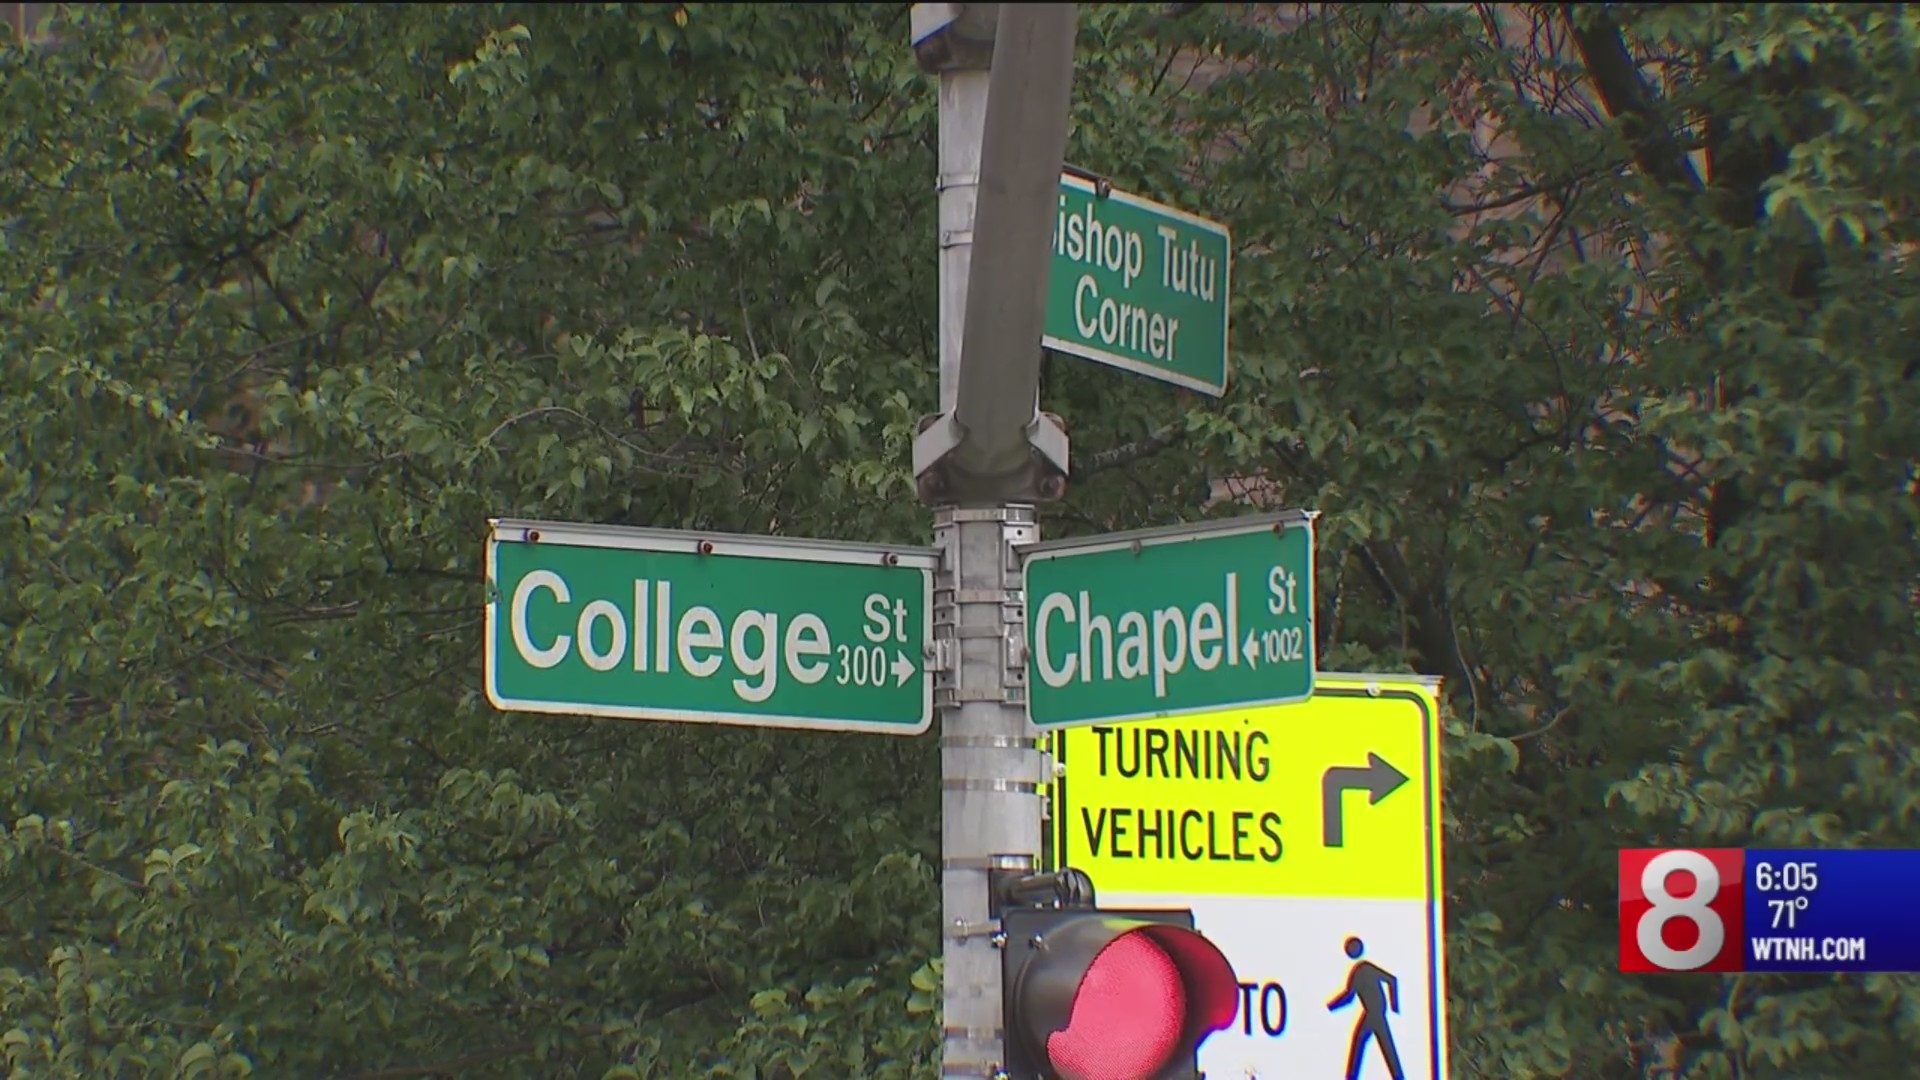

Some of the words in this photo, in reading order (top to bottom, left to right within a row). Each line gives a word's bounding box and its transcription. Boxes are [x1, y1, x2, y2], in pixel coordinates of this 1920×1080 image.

[1053, 195, 1142, 288] ishop
[1158, 224, 1215, 302] Tutu
[1075, 274, 1179, 362] Corner
[511, 569, 831, 702] College
[863, 593, 908, 643] St
[1035, 572, 1239, 698] Chapel
[1268, 566, 1297, 615] St
[1262, 627, 1303, 664] 1002
[836, 645, 887, 687] 300
[1092, 726, 1270, 782] TURNING
[1081, 807, 1283, 863] VEHICLES
[1238, 981, 1288, 1036] TO
